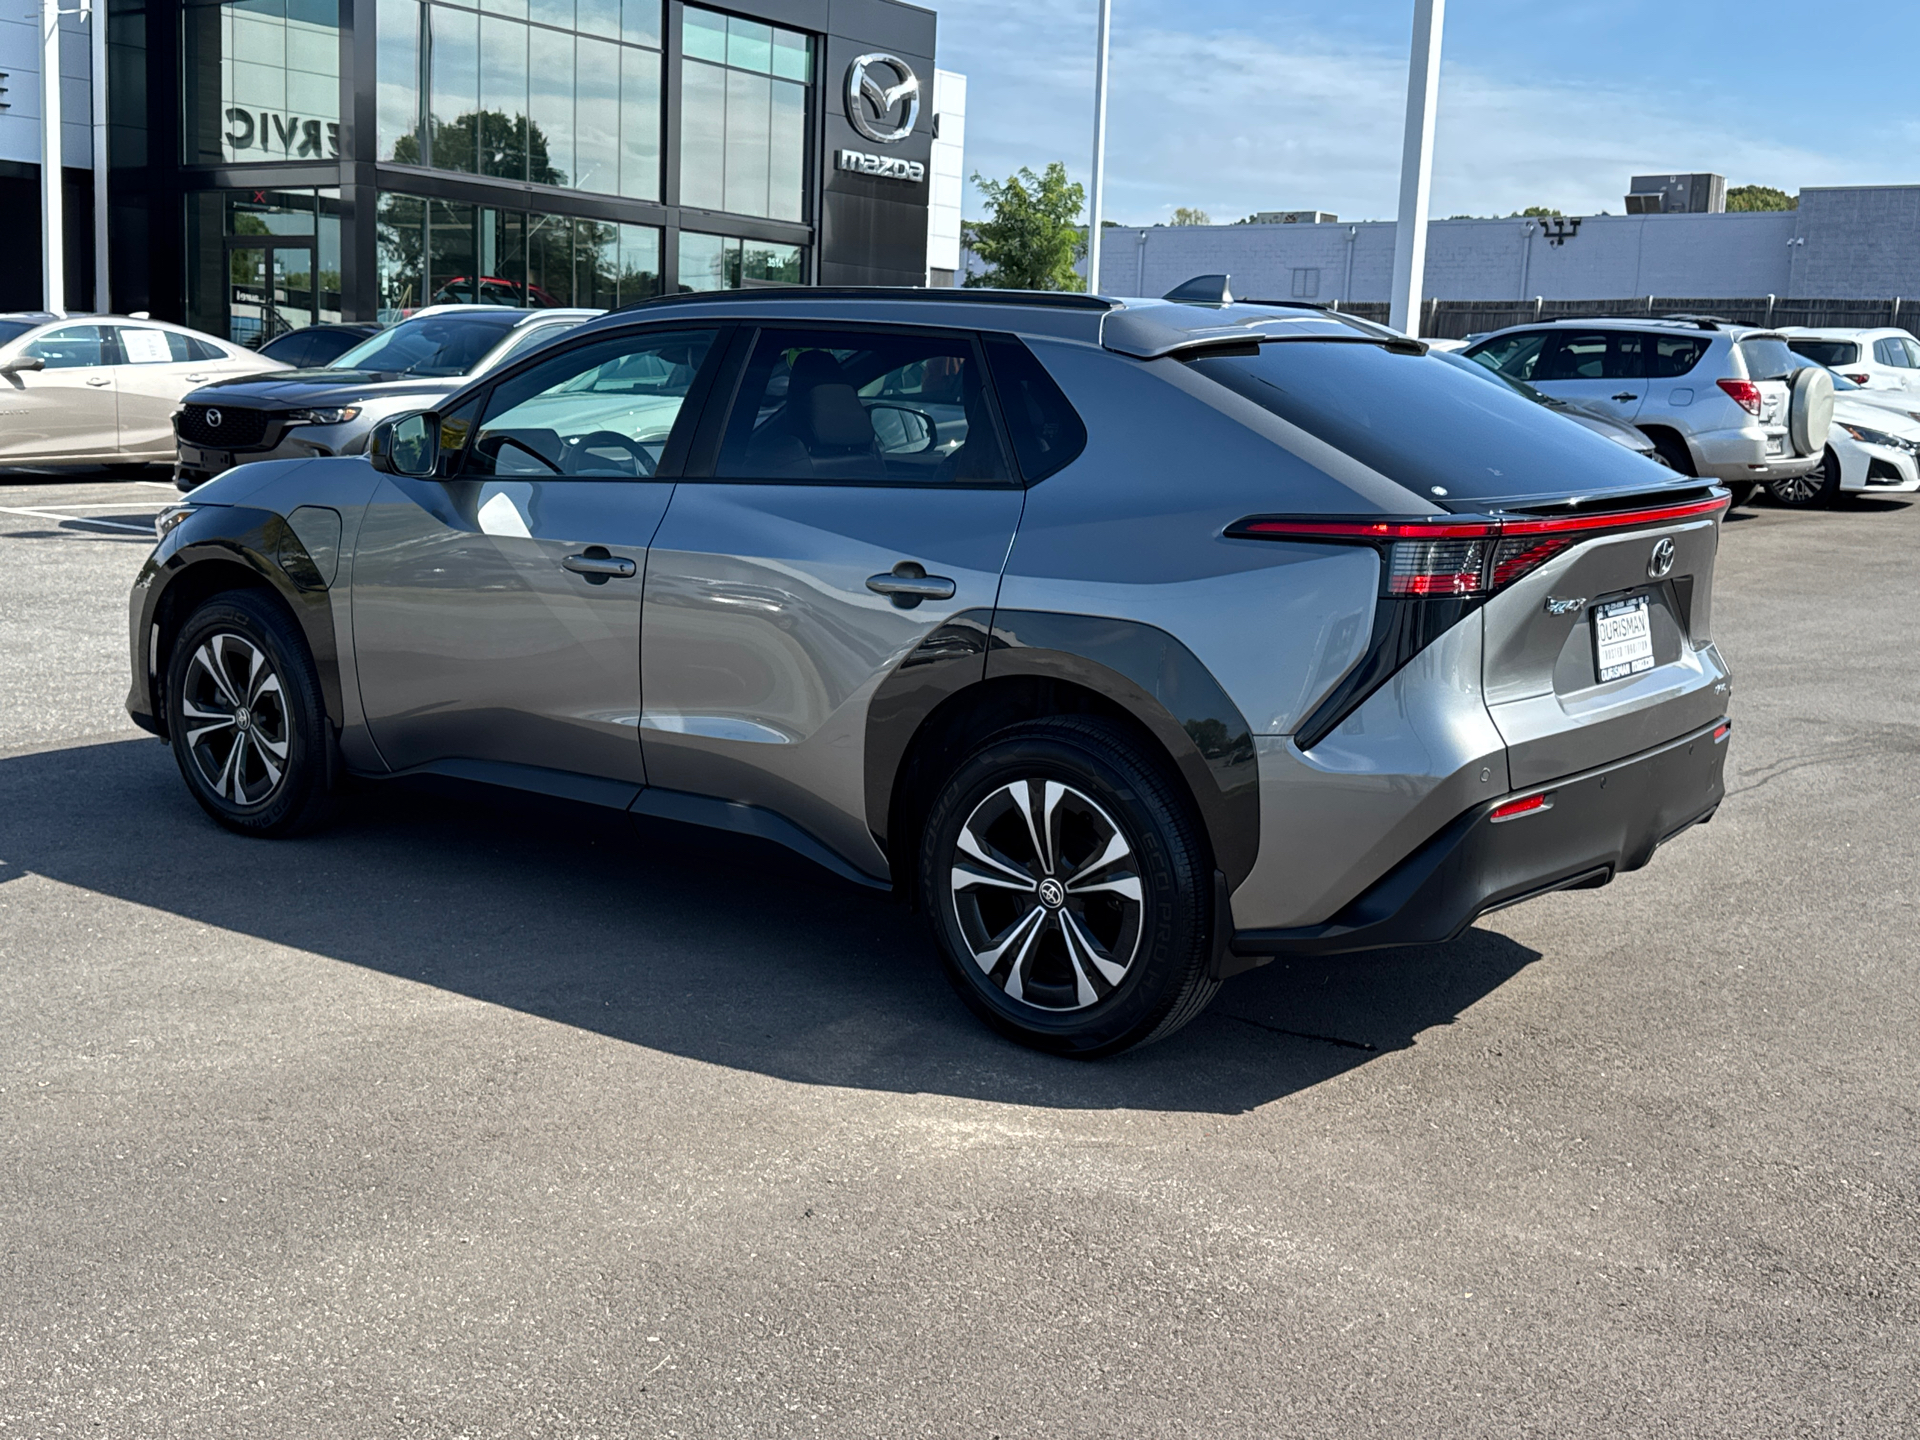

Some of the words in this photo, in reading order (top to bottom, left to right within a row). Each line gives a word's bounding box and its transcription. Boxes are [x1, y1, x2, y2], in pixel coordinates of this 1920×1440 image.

[834, 148, 925, 183] mazda
[1599, 614, 1646, 643] OURISMAN
[1601, 662, 1630, 682] OURISMAN
